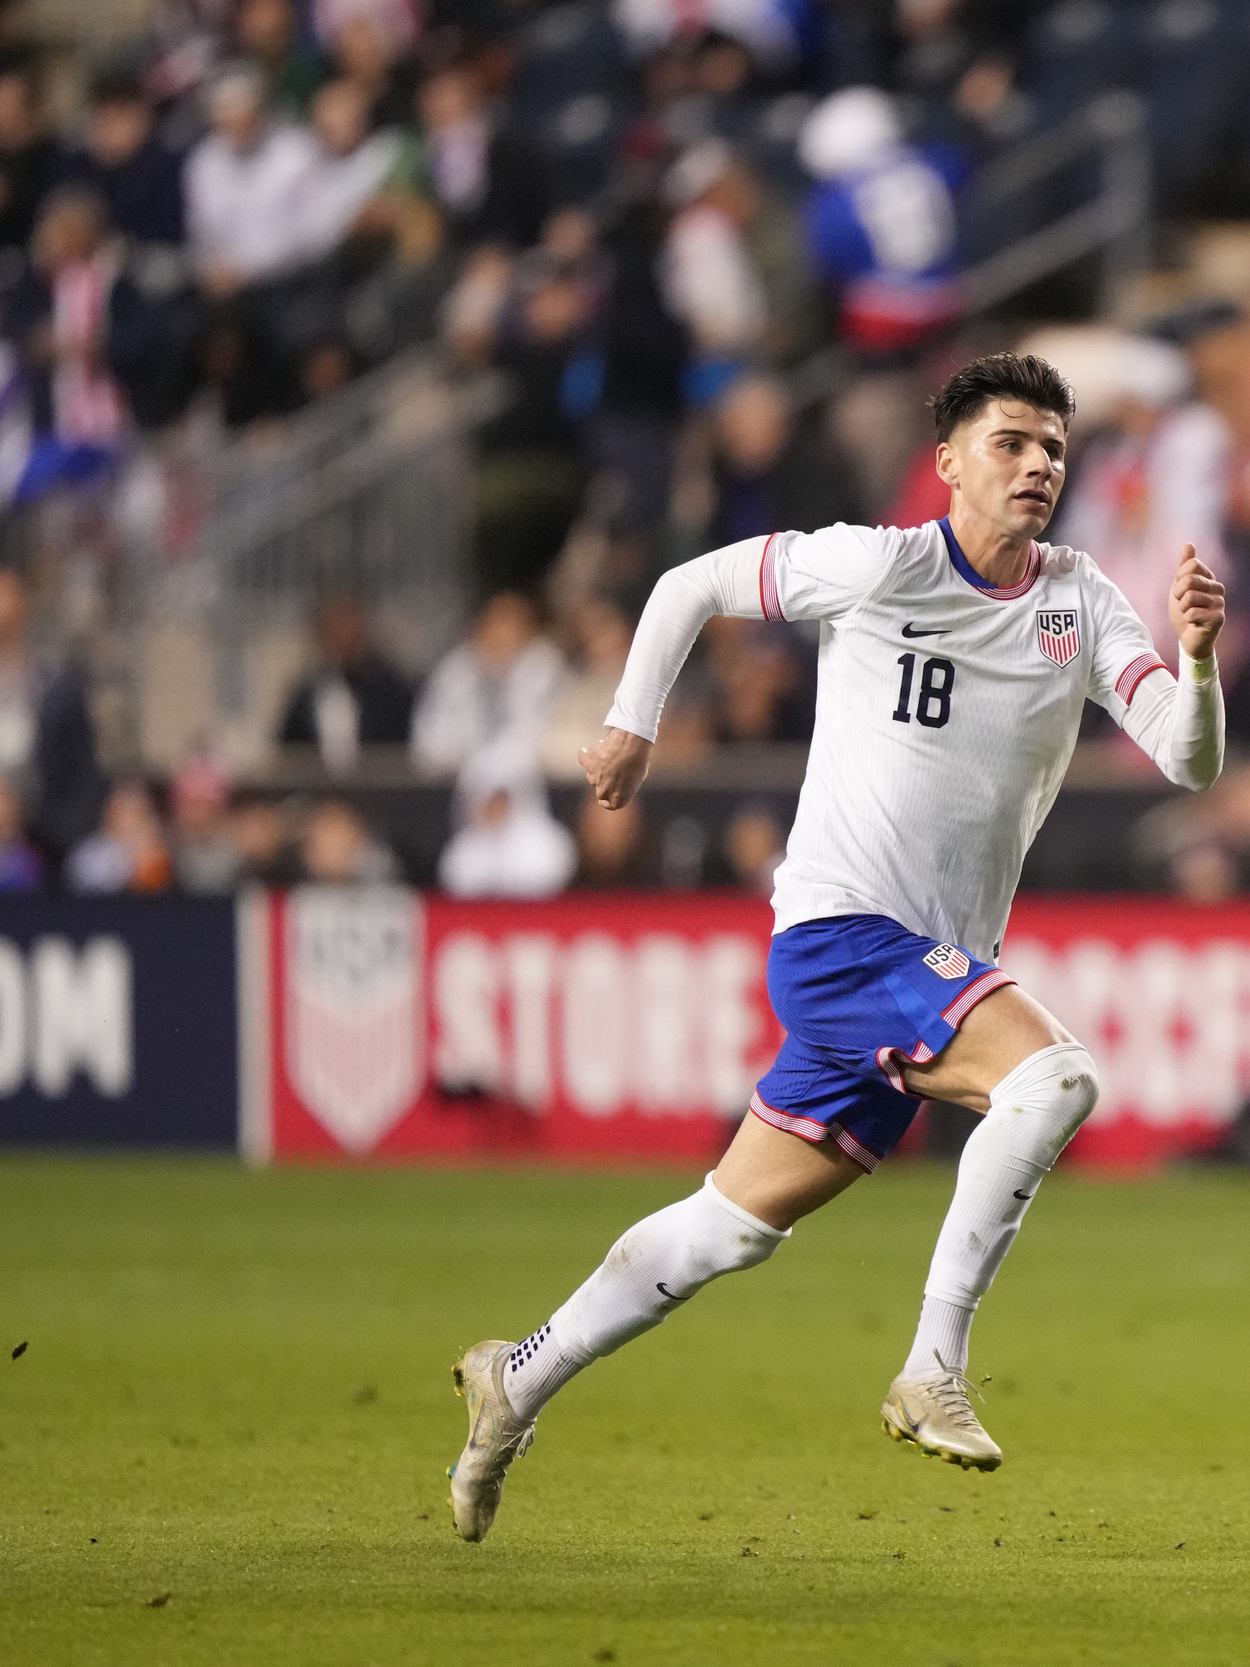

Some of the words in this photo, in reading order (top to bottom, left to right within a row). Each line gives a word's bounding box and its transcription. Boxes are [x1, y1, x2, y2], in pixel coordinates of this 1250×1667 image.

[1039, 614, 1074, 636] USA
[892, 652, 956, 729] 18
[925, 944, 954, 966] USA
